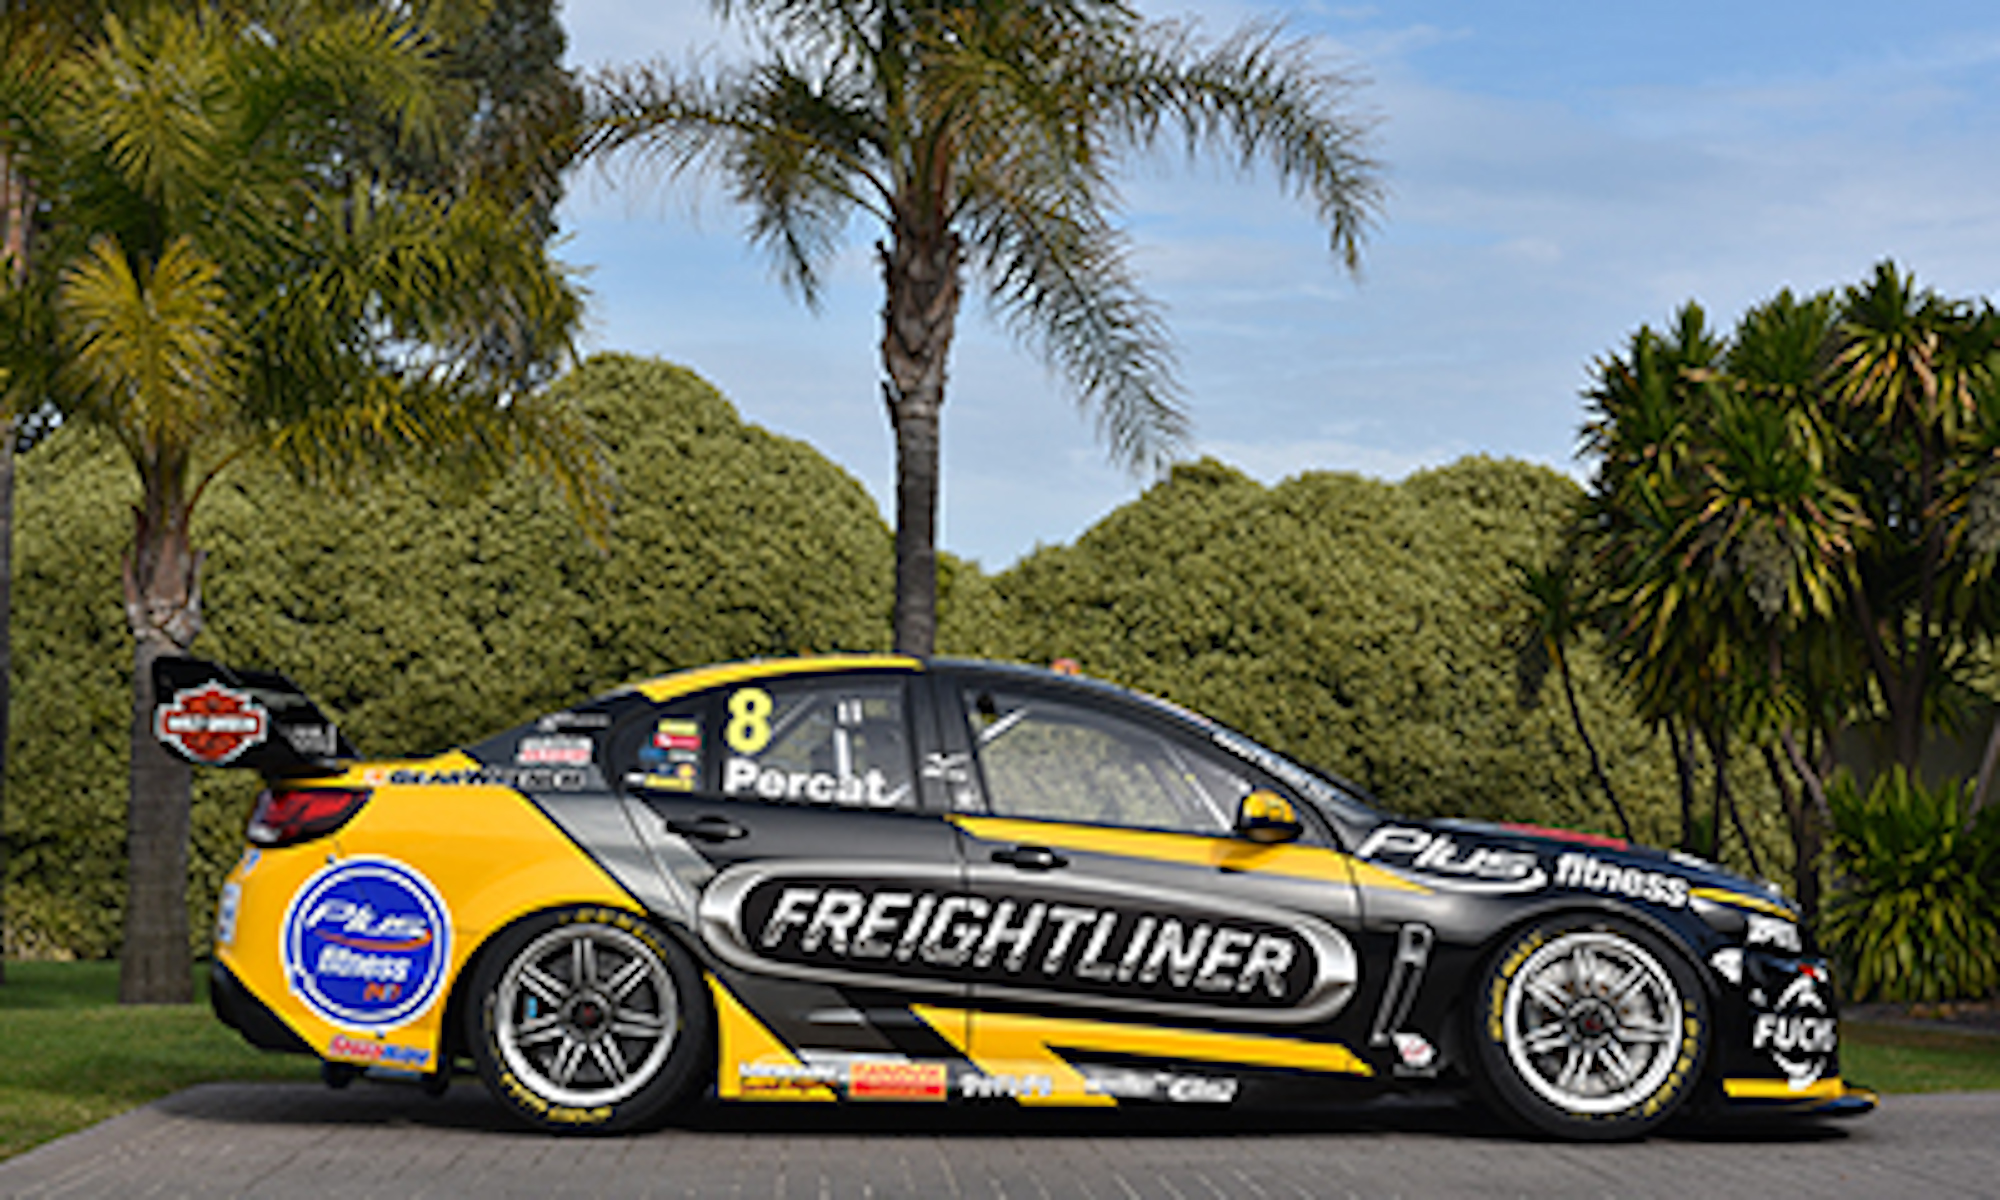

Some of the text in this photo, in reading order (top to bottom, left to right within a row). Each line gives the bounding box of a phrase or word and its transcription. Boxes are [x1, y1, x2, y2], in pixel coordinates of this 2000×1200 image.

[726, 687, 773, 752] 8
[725, 757, 884, 804] Percat
[1358, 826, 1688, 908] Plus fitness
[306, 898, 429, 939] Plus
[762, 886, 1295, 999] FREIGHTLINER
